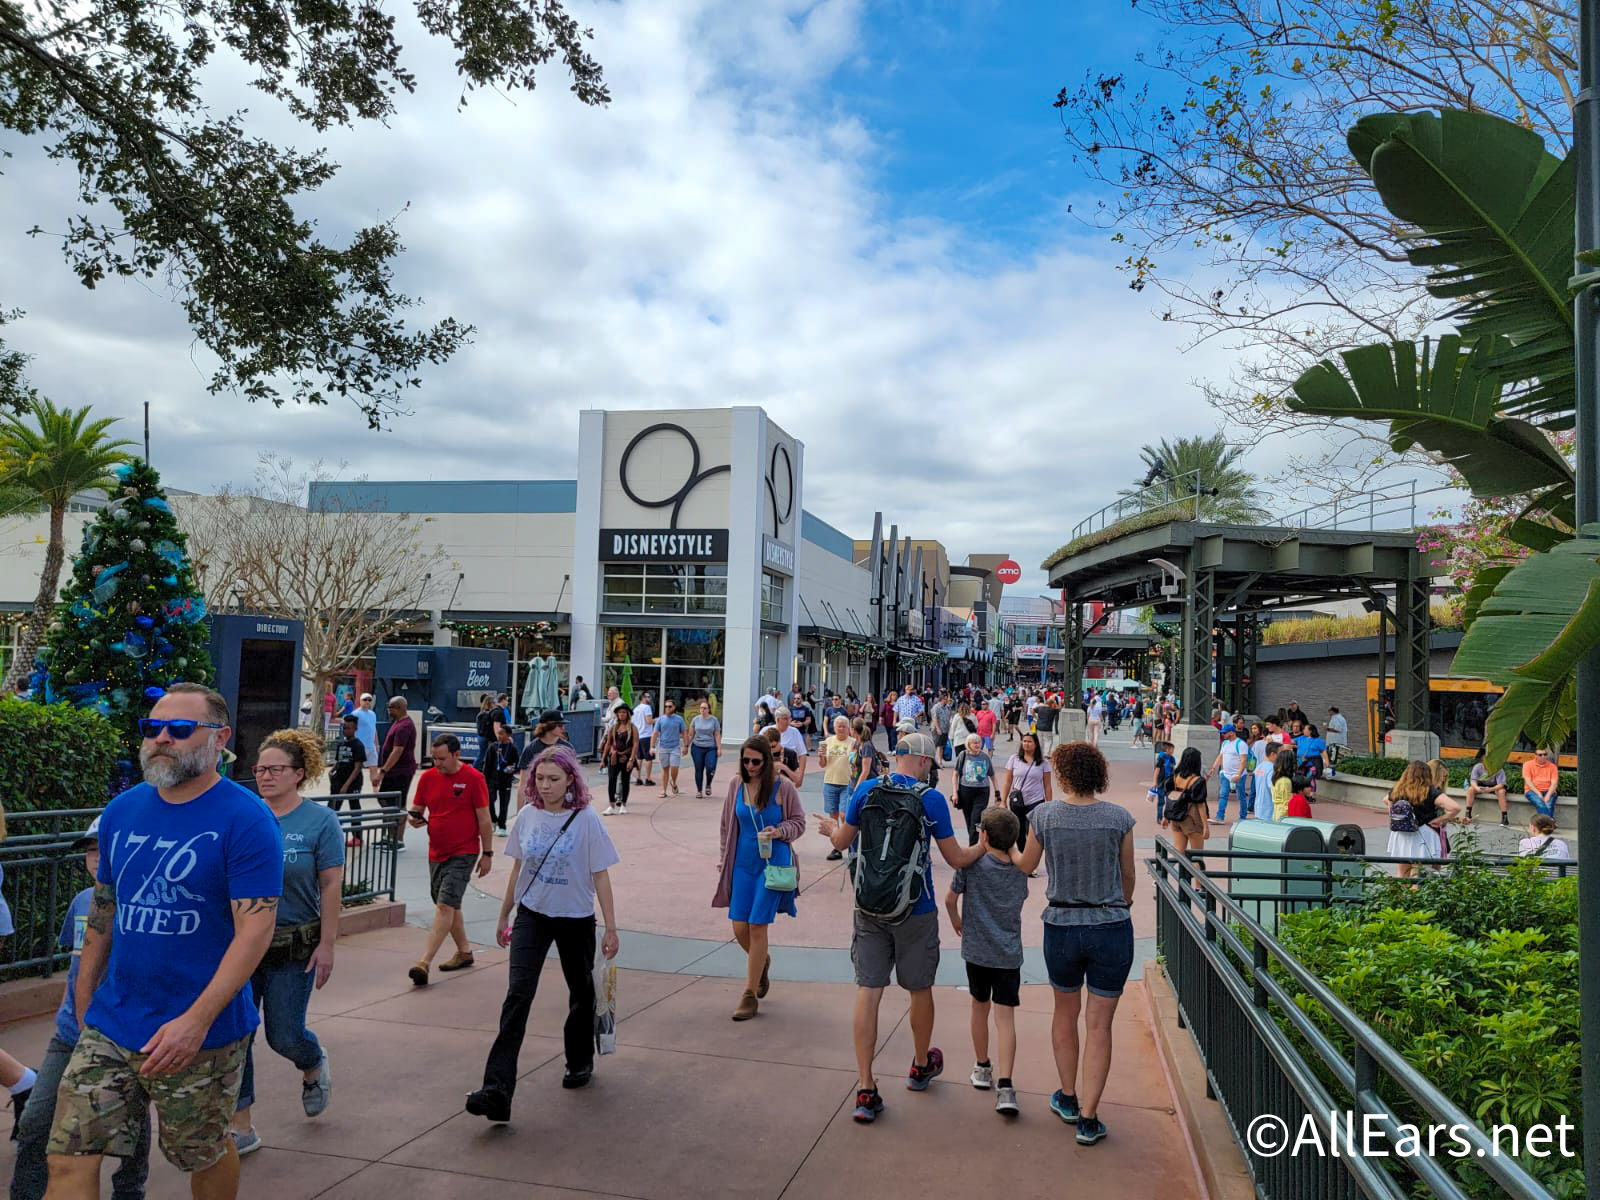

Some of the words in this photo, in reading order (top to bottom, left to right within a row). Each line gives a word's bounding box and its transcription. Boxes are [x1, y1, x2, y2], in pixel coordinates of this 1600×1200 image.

[613, 534, 713, 555] DISNEYSTYLE
[256, 623, 288, 634] DIRECTORY
[469, 660, 477, 668] ICE
[478, 660, 491, 669] COLD
[467, 669, 490, 687] Beer
[285, 833, 305, 842] FOR
[110, 830, 219, 903] 1776
